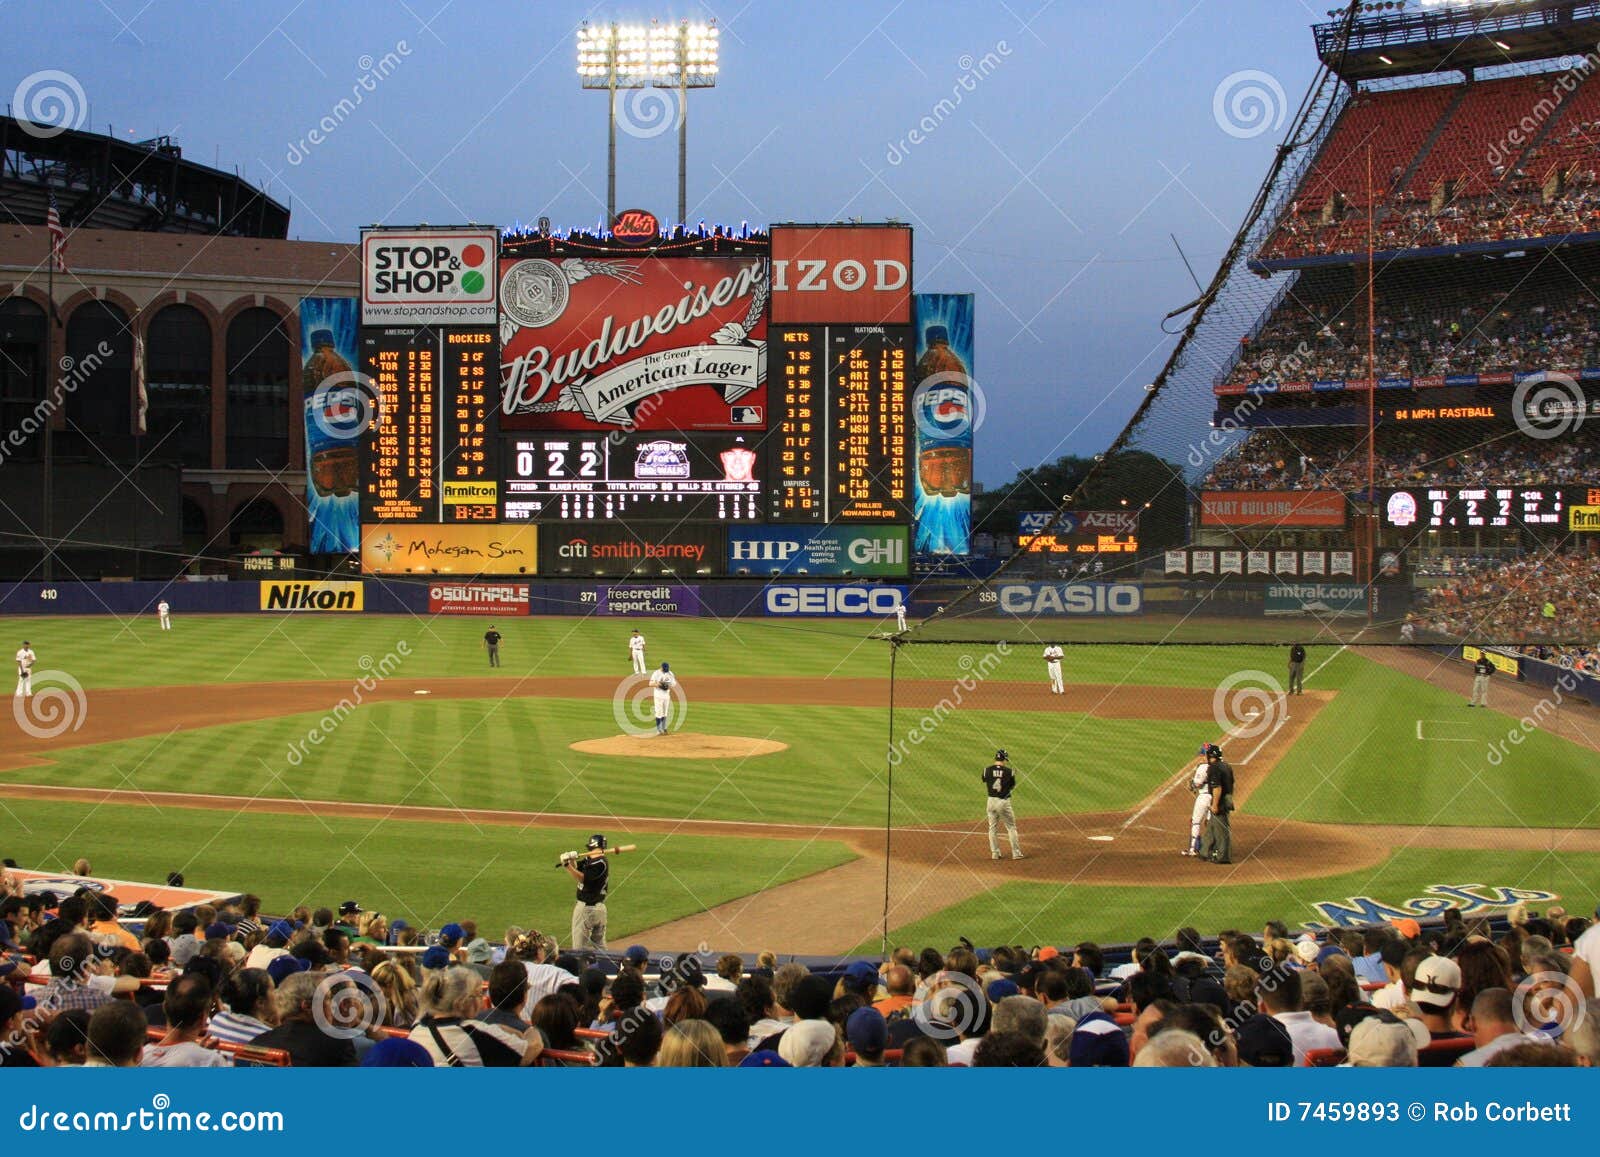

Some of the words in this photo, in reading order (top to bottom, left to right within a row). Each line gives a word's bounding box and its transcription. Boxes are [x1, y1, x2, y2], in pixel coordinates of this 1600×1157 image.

[613, 213, 655, 236] Mets
[375, 246, 450, 270] STOP
[448, 256, 461, 271] &
[773, 259, 908, 292] IZOD
[375, 271, 454, 294] SHOP
[365, 305, 496, 317] www.stopandshop.com
[385, 328, 414, 336] AMERICAN
[854, 326, 885, 334] NATIONAL
[448, 333, 492, 344] ROCKIES
[500, 261, 764, 417] Budweiser
[783, 332, 809, 343] METS
[643, 355, 662, 365] The
[663, 350, 691, 362] Great
[849, 349, 863, 359] SF
[380, 361, 399, 371] TOR
[849, 359, 869, 370] CHC
[379, 372, 398, 383] BAL
[849, 370, 869, 381] ARI
[379, 382, 398, 392] BOS
[596, 362, 688, 407] American
[692, 357, 753, 378] Lager
[849, 381, 869, 391] PHI
[849, 392, 869, 403] STL
[379, 403, 399, 414] DET
[849, 402, 870, 413] PIT
[1395, 410, 1408, 419] 94
[1412, 409, 1435, 419] MPH
[1439, 407, 1495, 418] FASTBALL
[379, 425, 398, 435] CLE
[380, 446, 399, 456] TEX
[849, 445, 869, 456] MIL
[379, 457, 398, 468] SEA
[517, 452, 533, 476] 0
[548, 452, 566, 476] 2
[580, 452, 597, 476] 2
[849, 457, 869, 467] ATL
[849, 467, 863, 478] SD
[849, 478, 869, 489] FLA
[379, 488, 398, 499] OAK
[445, 485, 496, 496] Armitron
[849, 489, 869, 499] LAD
[1204, 501, 1238, 515] START
[1241, 501, 1293, 515] BUILDING
[1432, 500, 1443, 516] 0
[1466, 500, 1477, 516] 2
[1499, 500, 1510, 516] 2
[1082, 513, 1128, 527] AZEK
[408, 540, 484, 559] Mohegan
[488, 542, 525, 557] Sun
[559, 538, 587, 558] citi
[592, 541, 640, 558] smith
[645, 542, 705, 562] barney
[731, 540, 800, 560] HIP
[847, 537, 904, 565] GHI
[244, 557, 273, 570] HOME
[40, 589, 57, 600] 410
[267, 584, 356, 609] Nikon
[442, 587, 529, 603] SOUTHPOLE
[580, 591, 598, 603] 371
[607, 587, 670, 600] freecredit
[979, 592, 998, 603] 358
[1268, 584, 1364, 600] amtrak.com
[767, 587, 900, 613] GEICO
[999, 585, 1141, 614] CASIO
[607, 600, 678, 613] report.com
[992, 778, 1002, 792] 4
[1299, 882, 1558, 928] Mets
